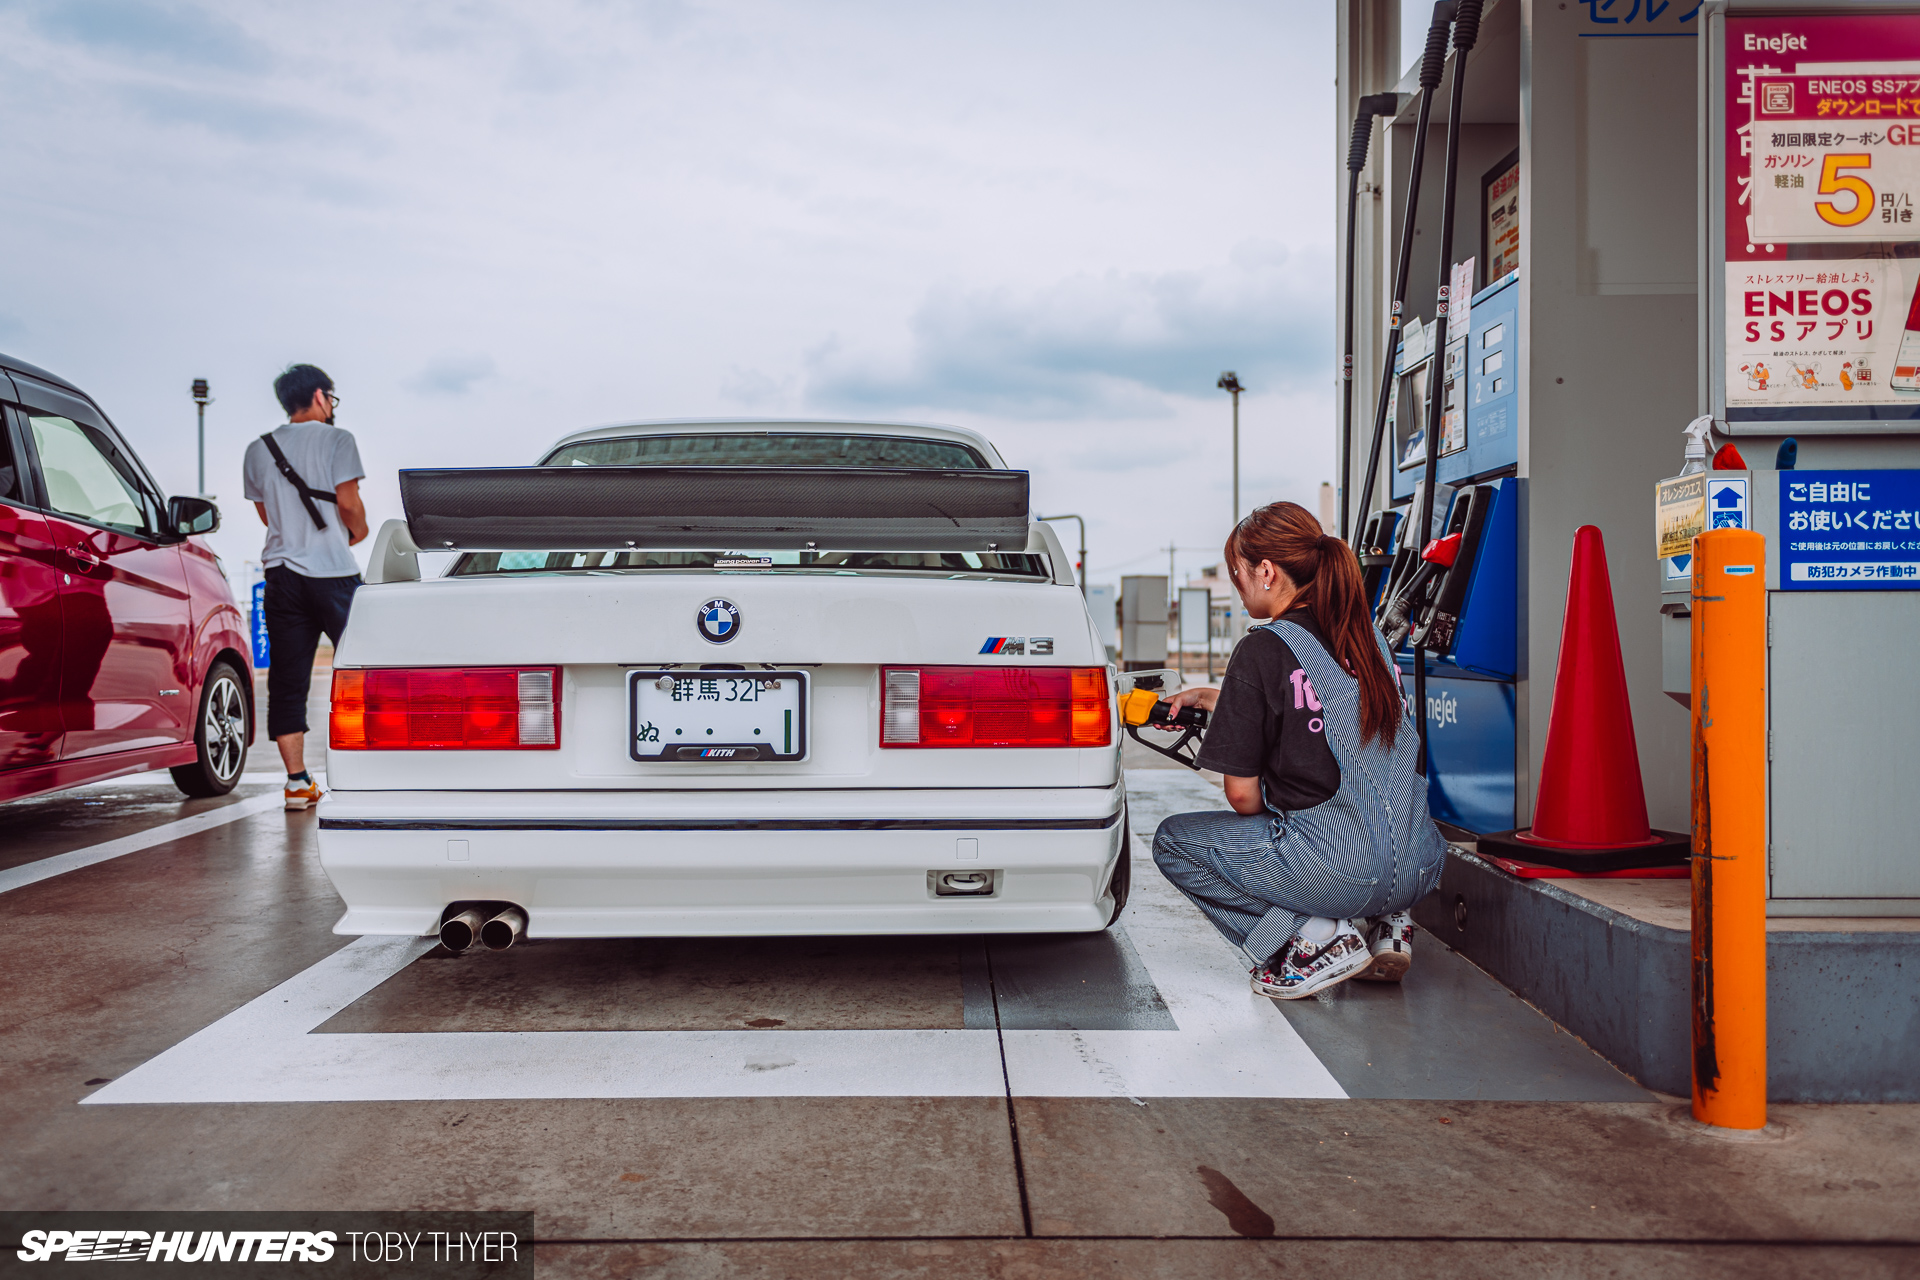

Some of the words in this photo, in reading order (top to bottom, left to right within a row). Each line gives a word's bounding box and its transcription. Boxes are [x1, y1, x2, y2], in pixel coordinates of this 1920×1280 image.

[1808, 80, 1867, 95] ENEOS
[1764, 154, 1814, 169] ガソリン
[1774, 174, 1804, 189] 軽油
[1814, 153, 1875, 228] 5
[1882, 208, 1913, 224] 引き
[1744, 272, 1875, 285] ストレスフリー給油しよう。
[1744, 288, 1873, 317] ENEOS
[1661, 481, 1702, 503] オレンジウエス
[1788, 481, 1871, 503] ご自由に
[1788, 509, 1920, 531] お使いくださ
[1807, 565, 1917, 578] 防犯カメラ作動中
[701, 600, 738, 615] BMW
[999, 636, 1054, 656] M3
[636, 720, 660, 743] ぬ
[707, 748, 736, 757] KITH
